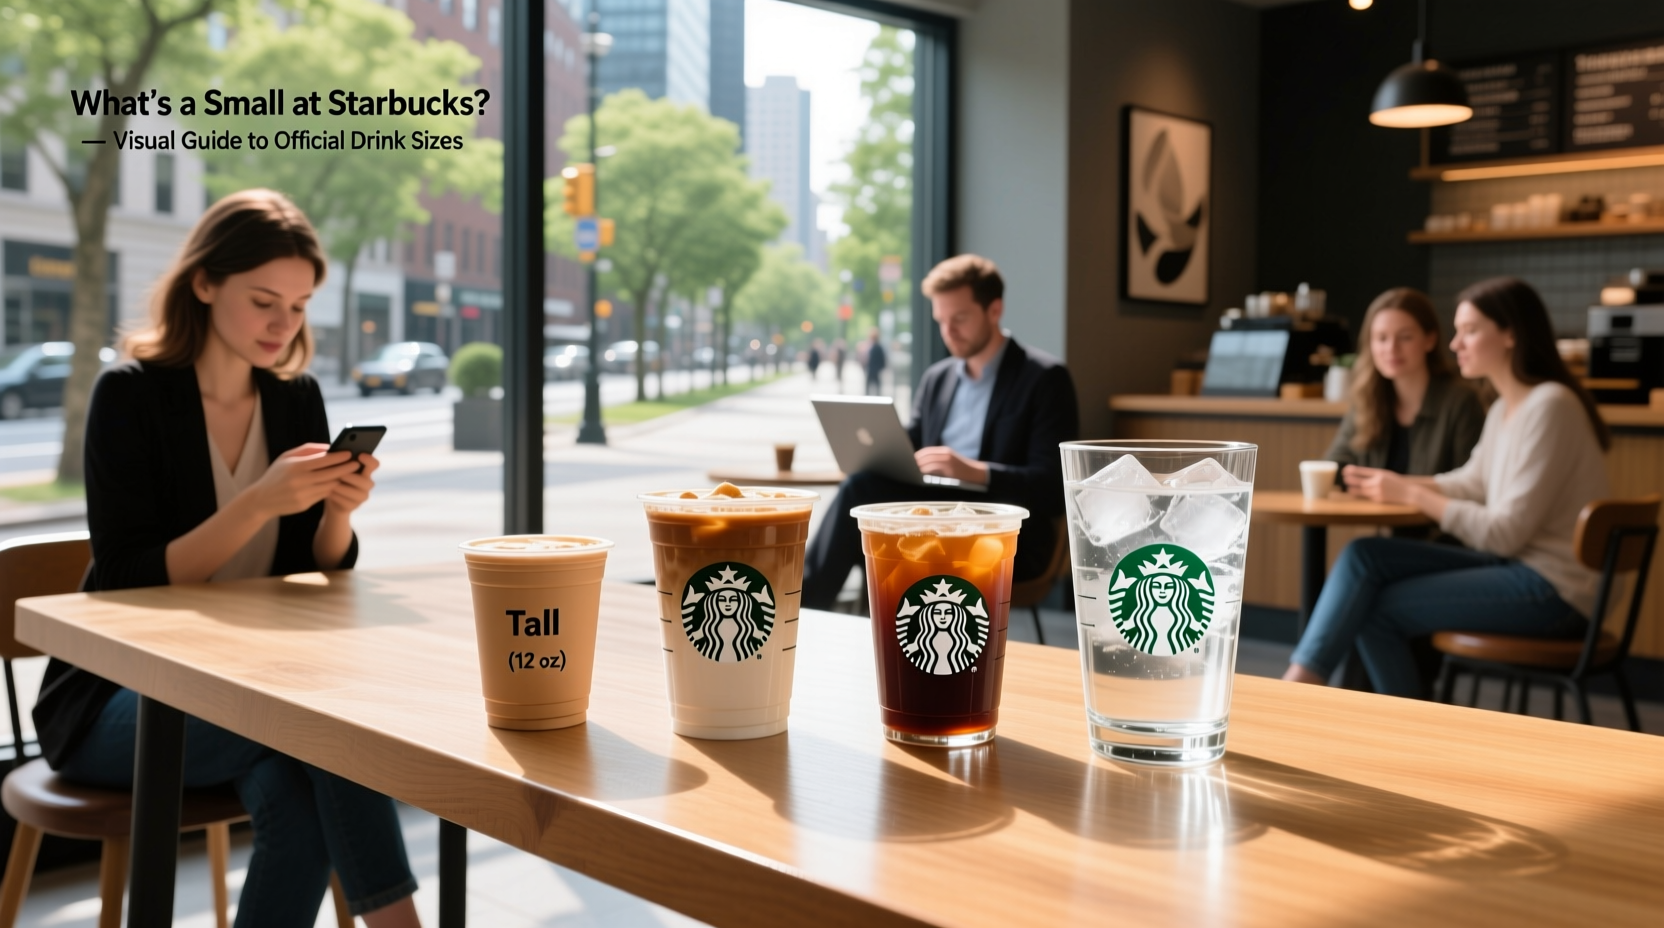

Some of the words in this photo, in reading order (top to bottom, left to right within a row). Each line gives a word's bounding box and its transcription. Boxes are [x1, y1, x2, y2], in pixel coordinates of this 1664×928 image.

[505, 608, 559, 637] Tall
[508, 651, 535, 673] (12
[539, 649, 566, 672] oz)
